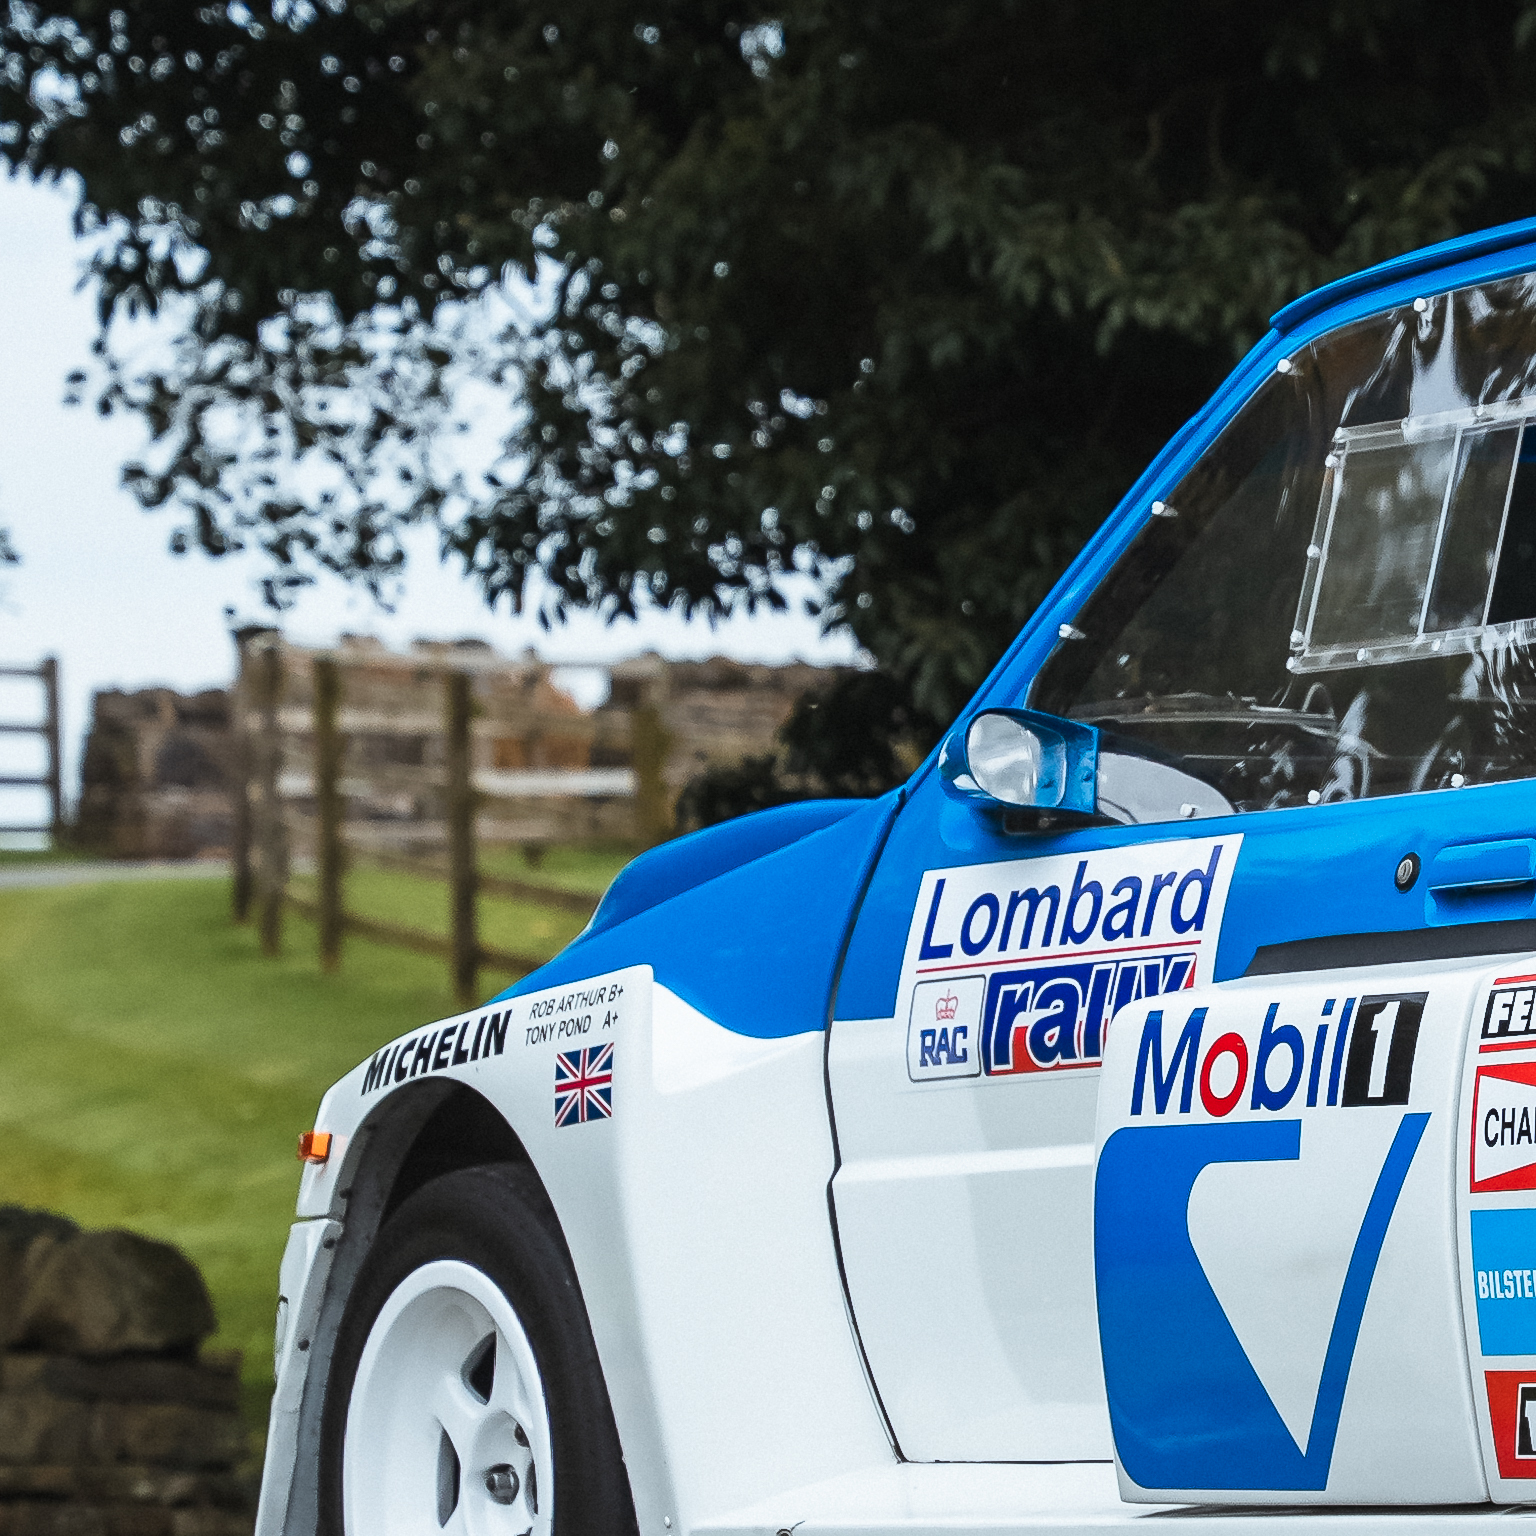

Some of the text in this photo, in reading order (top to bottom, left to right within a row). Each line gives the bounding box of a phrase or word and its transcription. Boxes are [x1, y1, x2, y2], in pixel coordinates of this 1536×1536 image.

[918, 845, 1223, 961] Lombard
[529, 983, 624, 1021] ROB ARTHUR B+
[526, 1010, 619, 1046] TONY POND A+
[919, 1025, 968, 1067] RAC
[360, 1008, 513, 1096] MICHELIN
